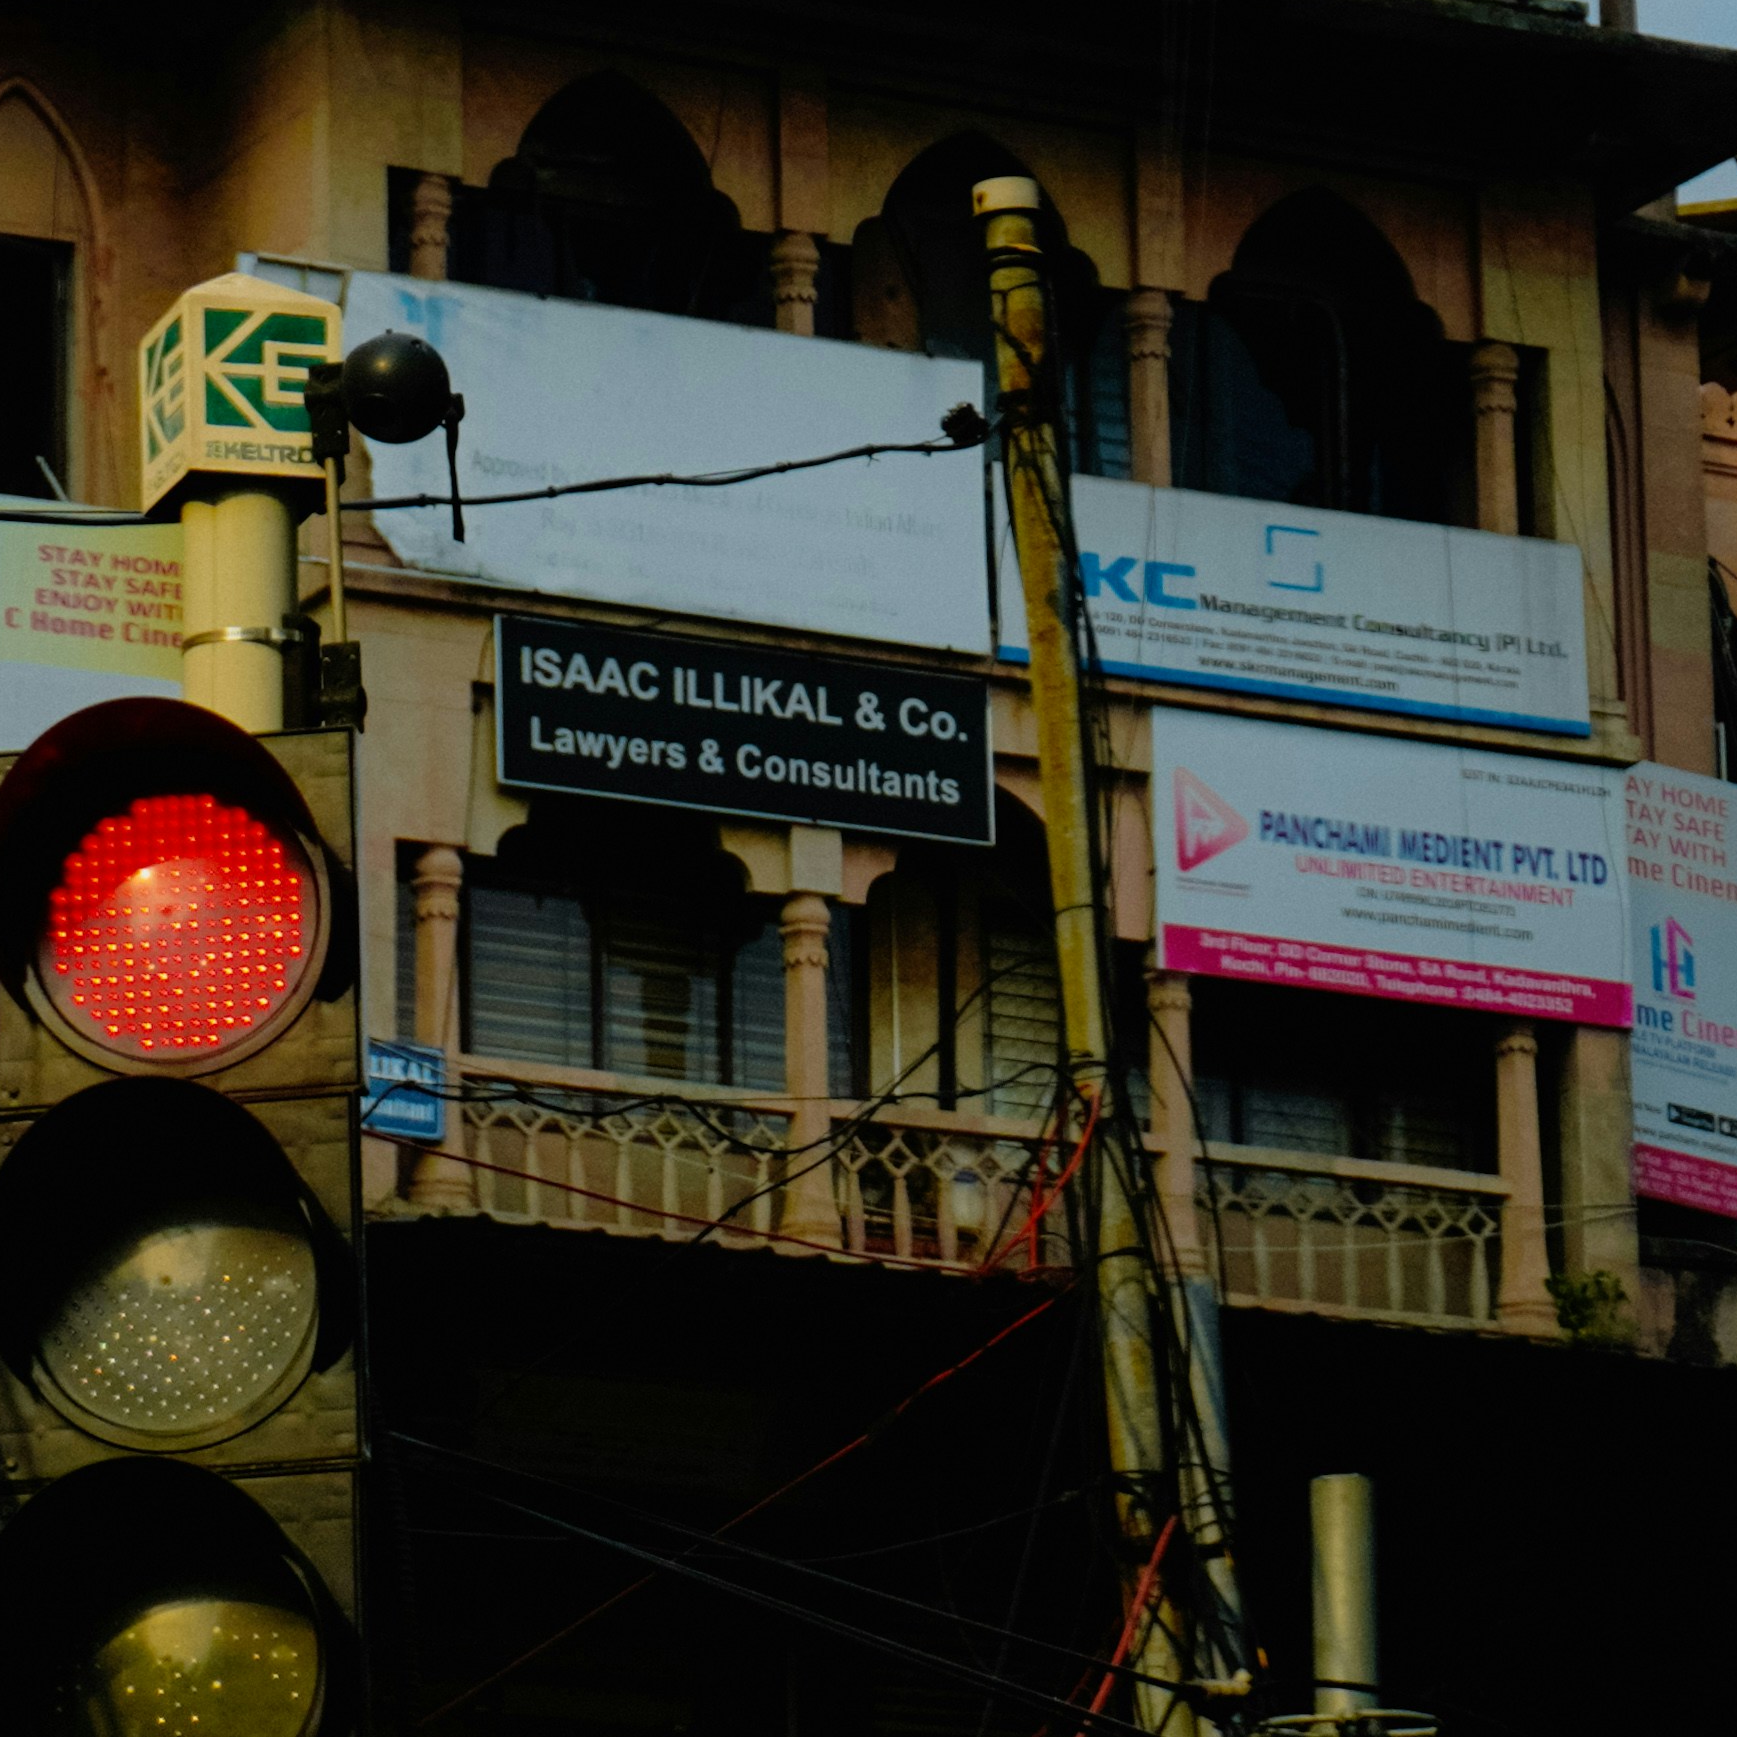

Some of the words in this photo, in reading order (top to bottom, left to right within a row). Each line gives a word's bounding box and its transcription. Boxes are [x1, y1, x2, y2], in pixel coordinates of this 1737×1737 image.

[224, 441, 317, 464] KELTRO
[39, 545, 104, 567] STAY
[111, 554, 181, 576] HOM
[52, 568, 117, 590] STAY
[35, 587, 118, 613] ENJOY
[127, 600, 183, 620] WIT
[1079, 551, 1196, 610] KC
[1200, 594, 1347, 627] Management
[1353, 615, 1491, 650] Consultancy
[1527, 637, 1568, 659] Ltd.
[30, 610, 115, 640] Home
[124, 621, 183, 647] Cine
[520, 645, 660, 702] ISAAC
[672, 665, 843, 727] ILLIKAL
[854, 690, 887, 732] &
[898, 696, 969, 743] Co.
[530, 715, 687, 770] Lawyers
[698, 737, 725, 776] &
[736, 743, 961, 806] Consultants
[1661, 783, 1729, 818] HOME
[1673, 812, 1725, 843] SAFE
[1258, 809, 1392, 858] PANCHAMI
[1397, 828, 1504, 873] MEDIENT
[1511, 843, 1559, 880] PVT.
[1568, 848, 1608, 885] LTD
[1668, 835, 1727, 867] WITH
[1295, 854, 1404, 886] UNLIMITED
[1411, 869, 1575, 907] ENTERTAINMENT
